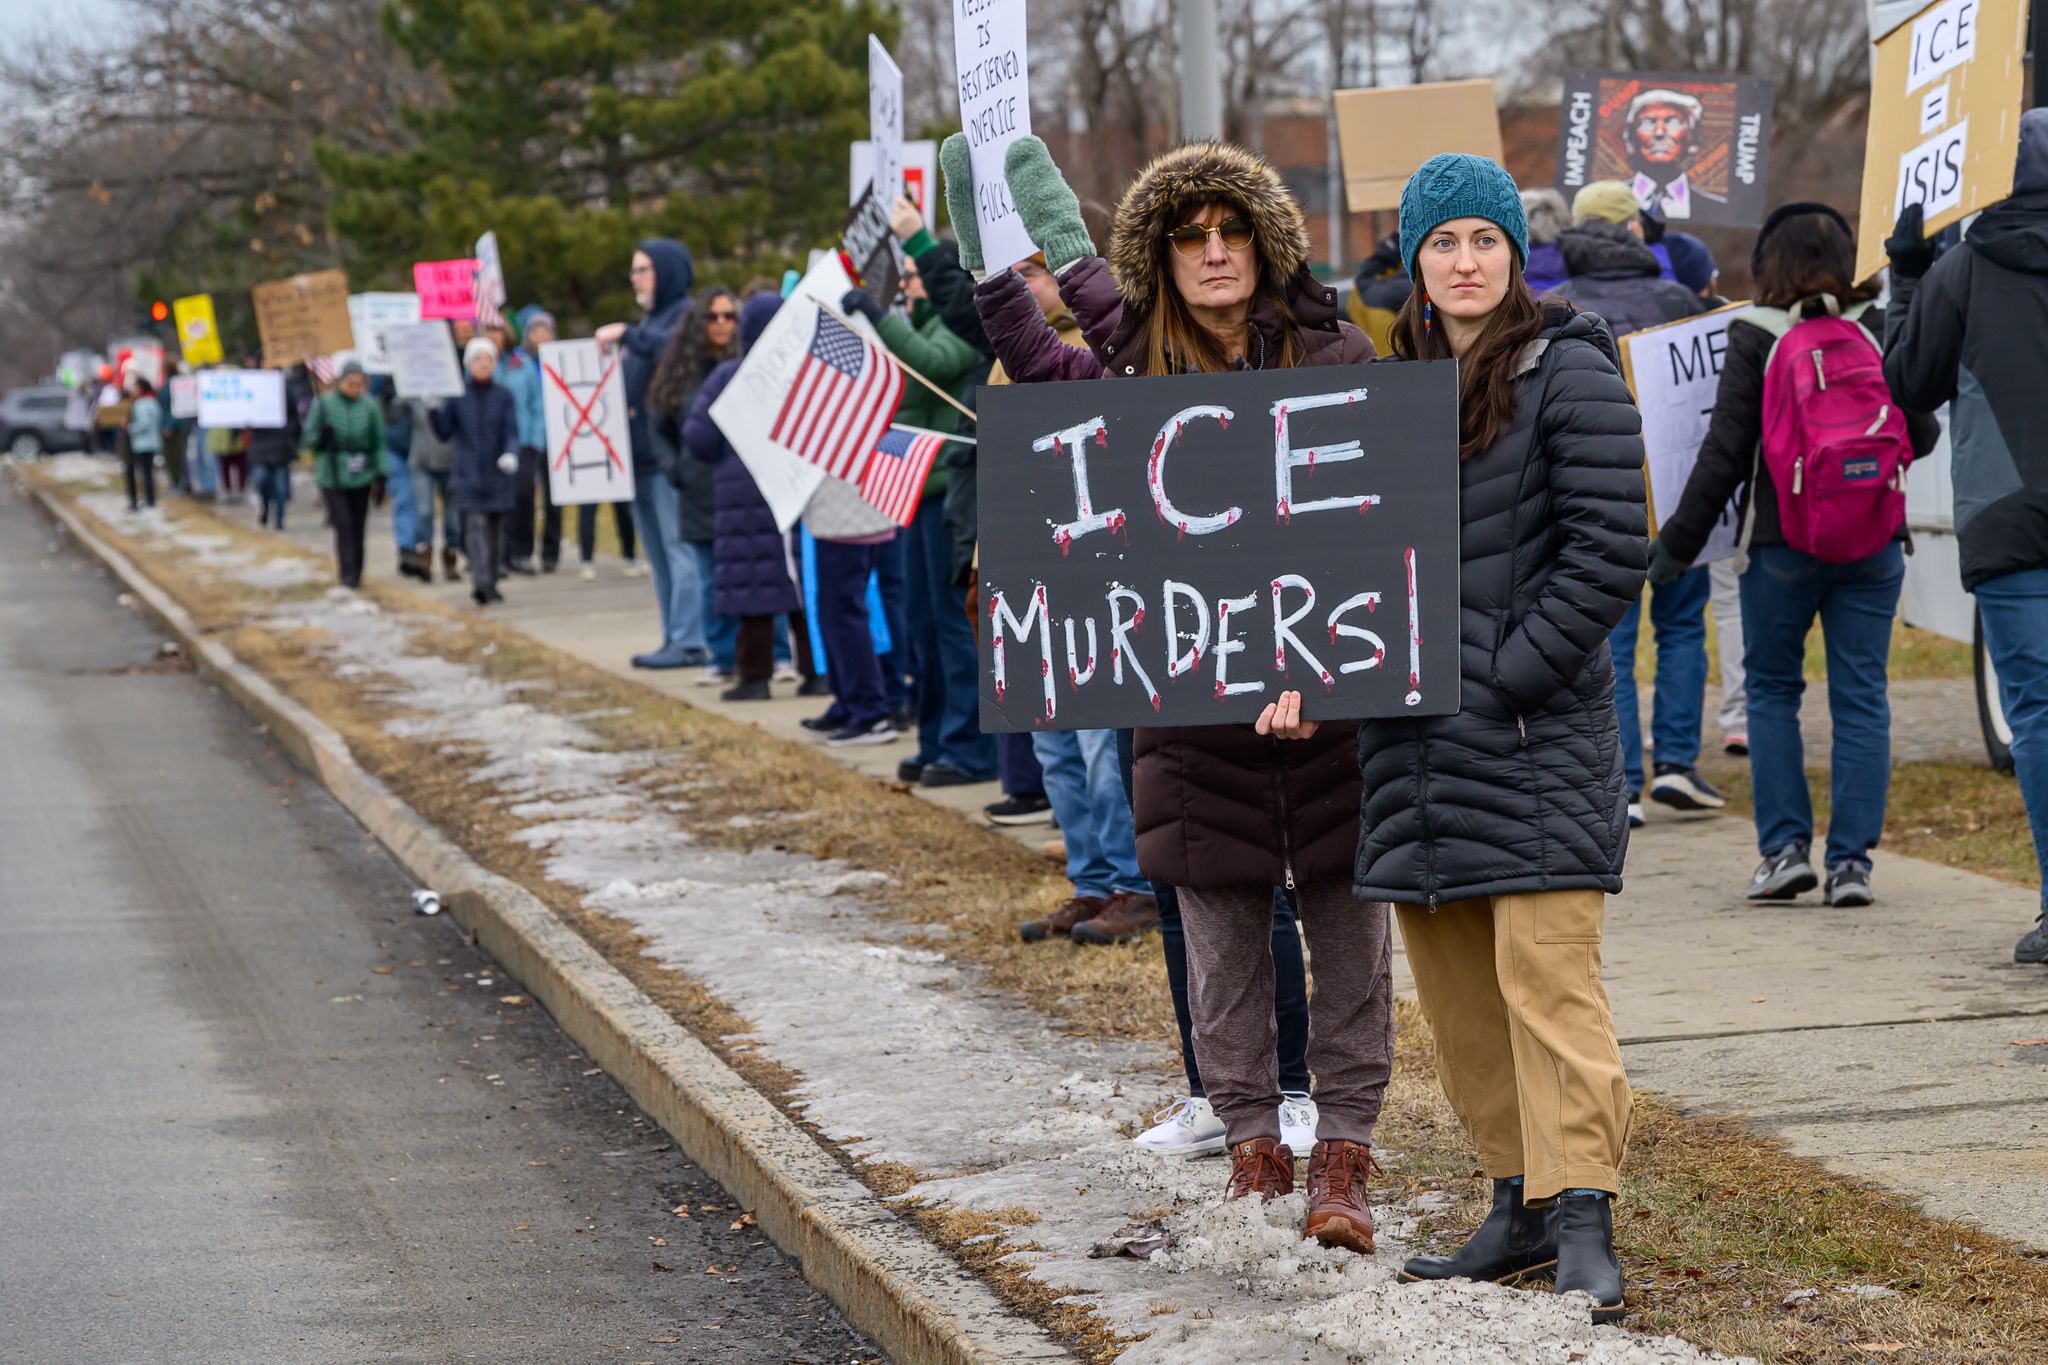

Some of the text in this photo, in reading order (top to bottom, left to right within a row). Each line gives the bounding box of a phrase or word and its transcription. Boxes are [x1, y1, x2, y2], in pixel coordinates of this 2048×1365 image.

[976, 20, 991, 48] IS
[961, 50, 1019, 103] BEST SERVED
[970, 97, 1016, 148] OVER ICE
[1564, 92, 1593, 186] IMPEACH
[1735, 113, 1761, 185] TRUMP
[979, 181, 1010, 224] FUCK
[1669, 329, 1728, 386] ME
[1032, 388, 1381, 548] ICE
[989, 546, 1423, 720] MURDERS!
